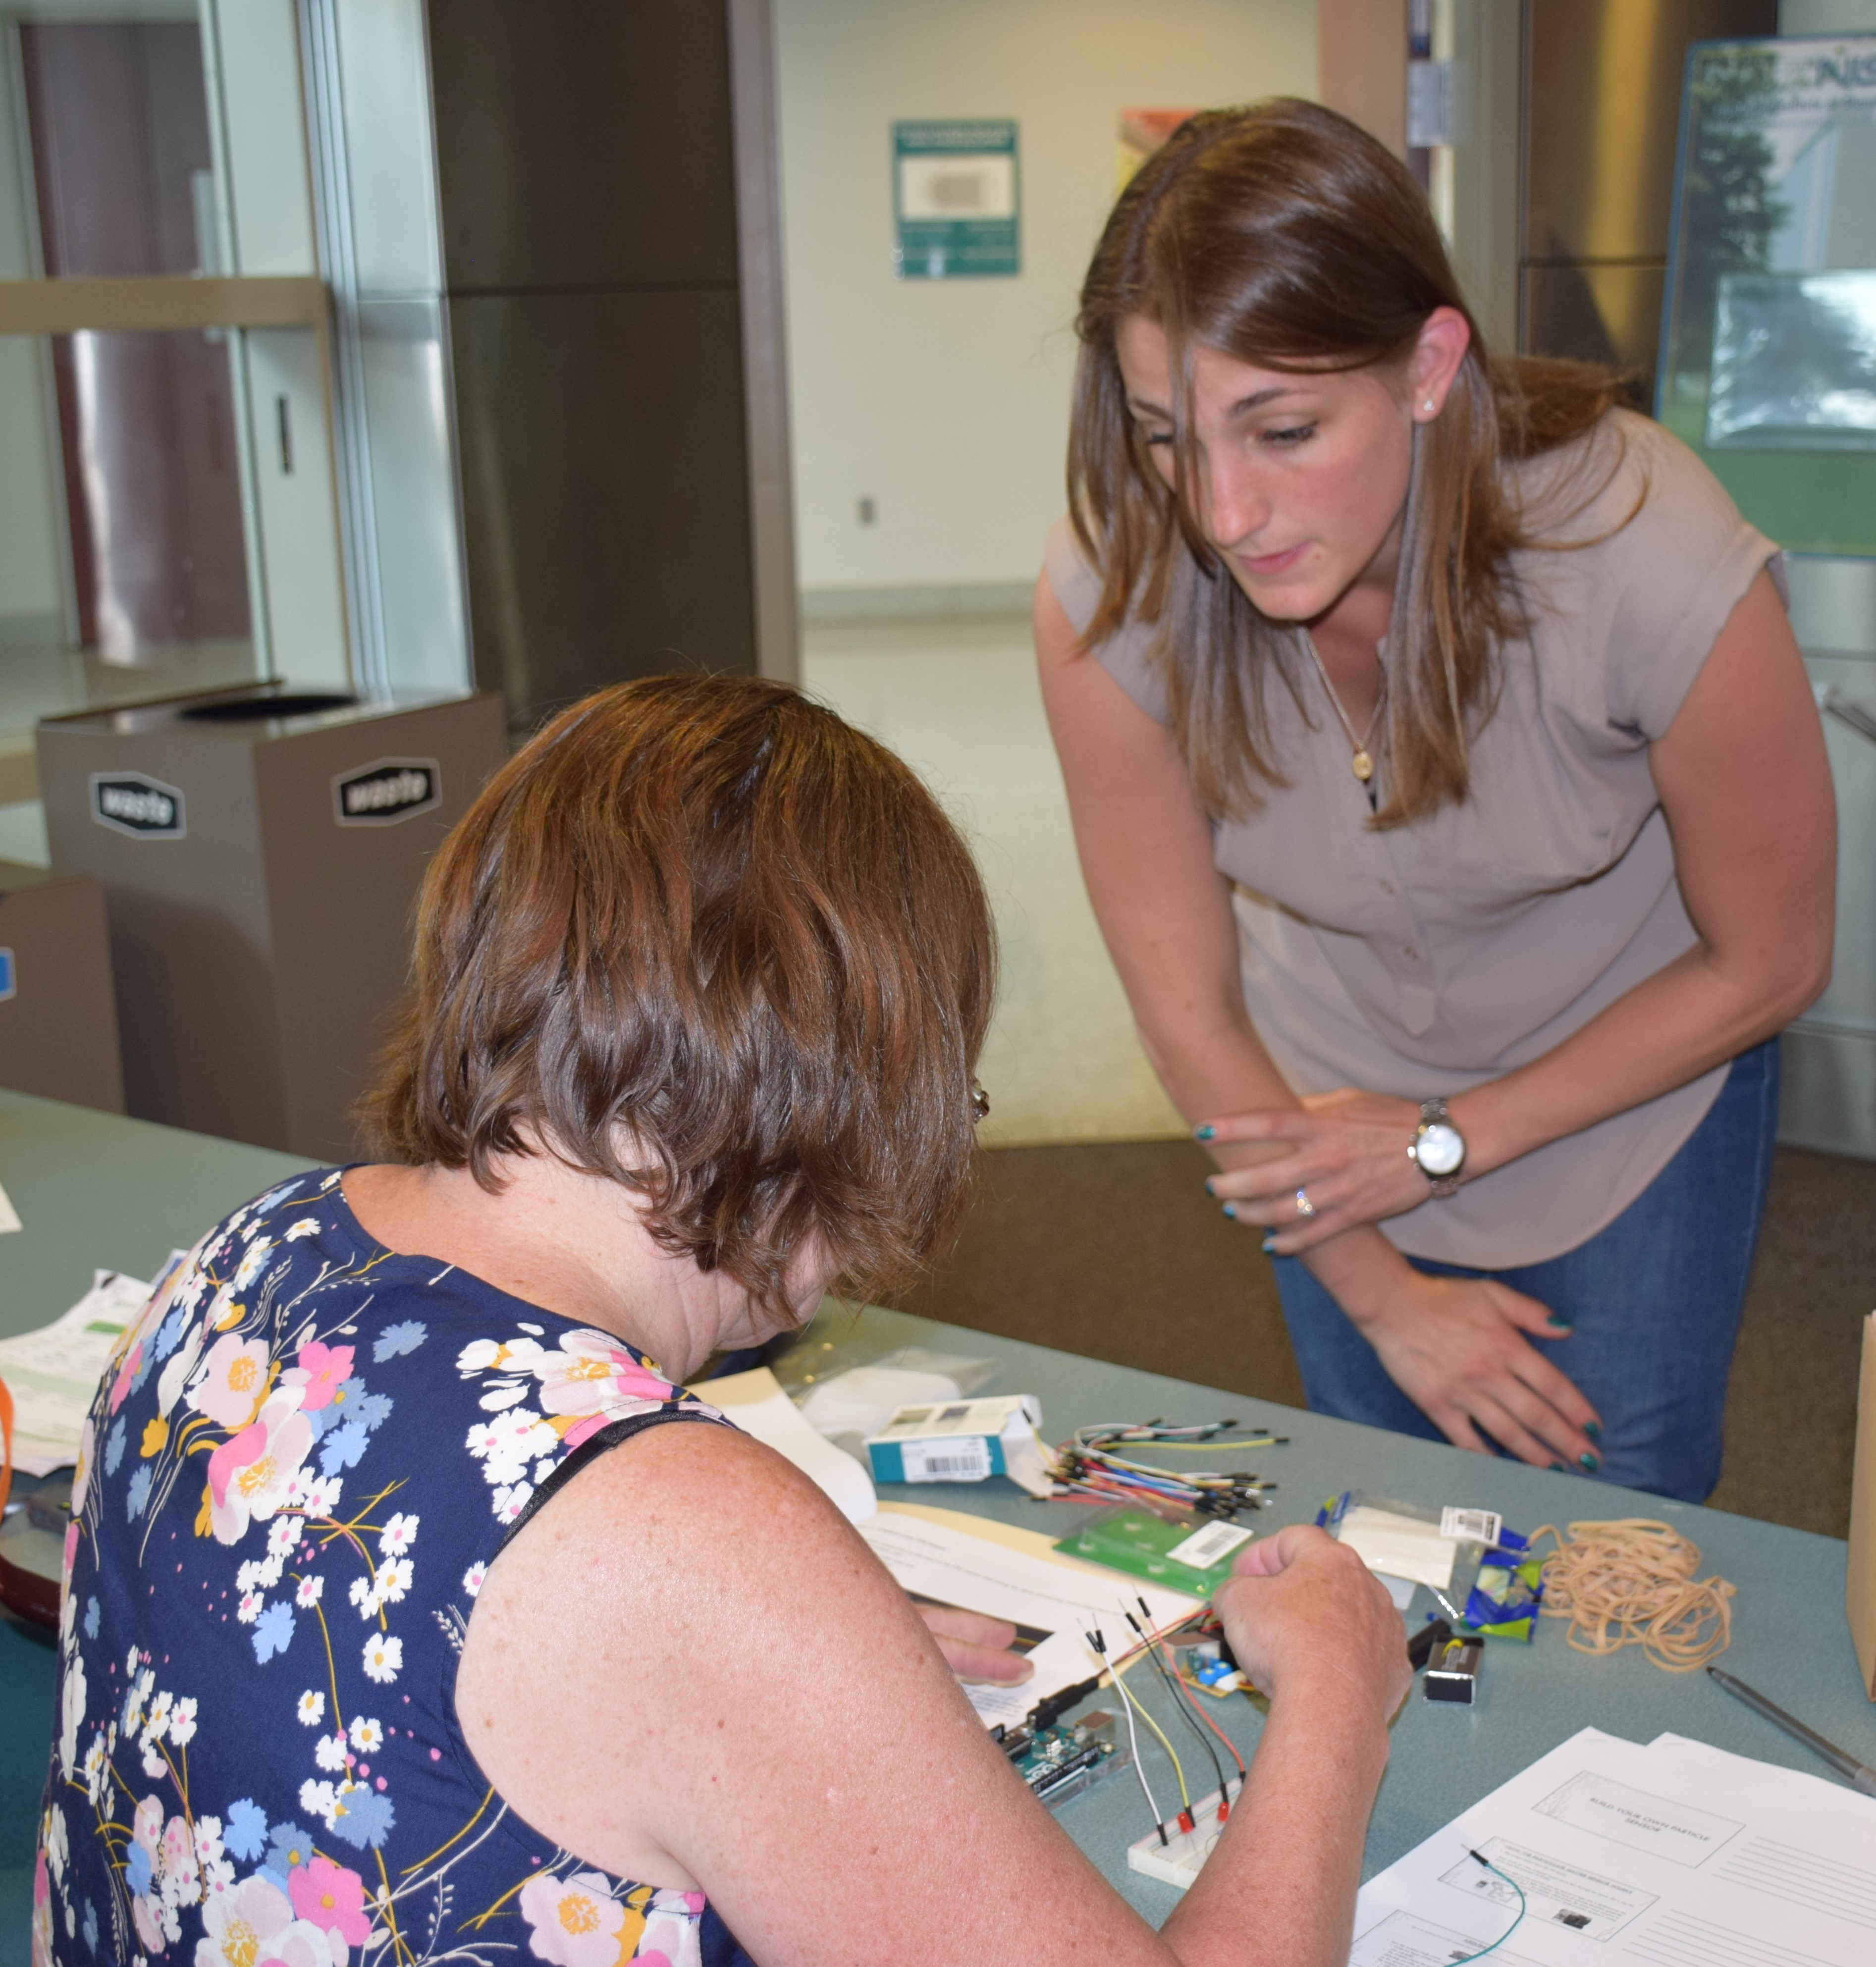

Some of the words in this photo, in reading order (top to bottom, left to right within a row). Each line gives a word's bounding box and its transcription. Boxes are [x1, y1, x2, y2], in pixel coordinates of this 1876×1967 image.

[102, 787, 173, 826] waste
[348, 769, 428, 813] waste
[1589, 1797, 1614, 1809] BUILD
[1616, 1807, 1641, 1819] YOUR
[1643, 1816, 1669, 1829] OWN
[1670, 1825, 1711, 1841] PARTICLE
[1624, 1817, 1662, 1832] SENSOR
